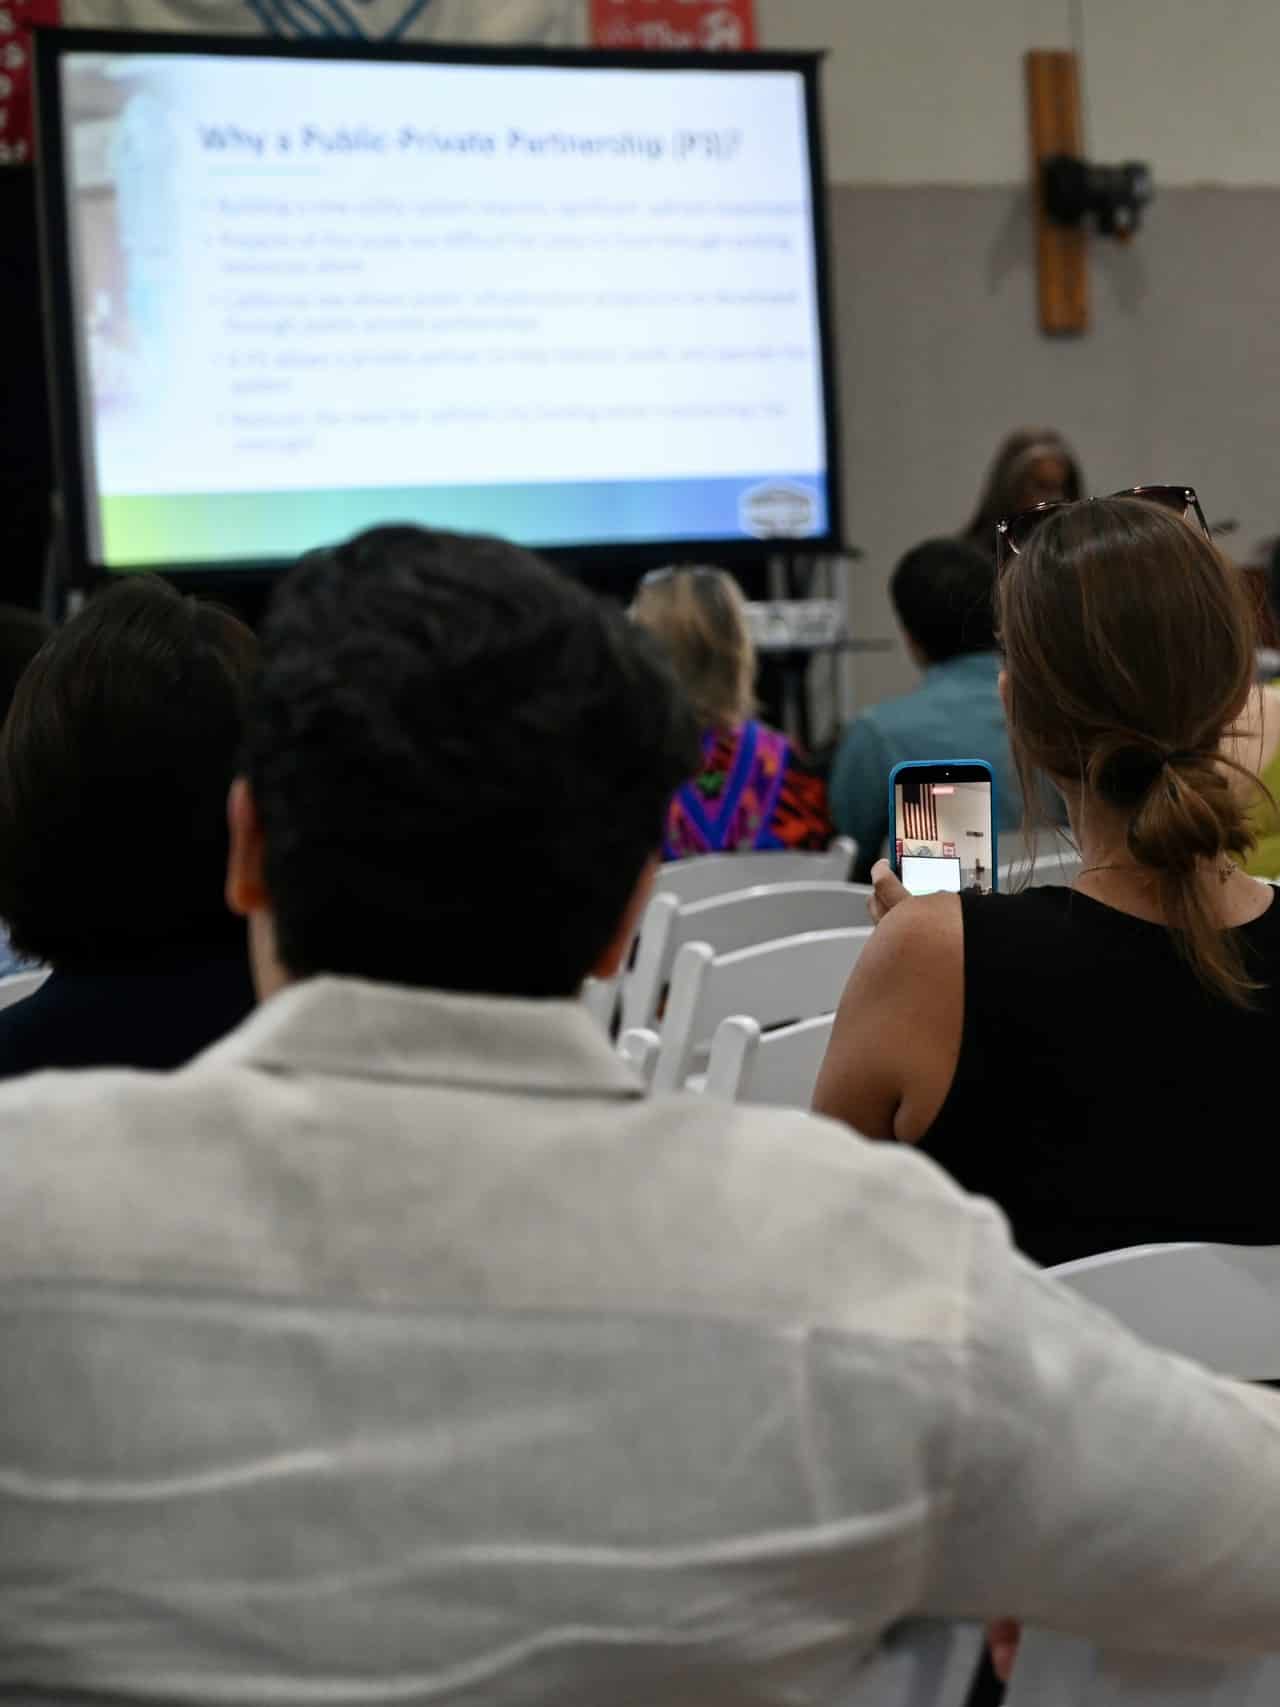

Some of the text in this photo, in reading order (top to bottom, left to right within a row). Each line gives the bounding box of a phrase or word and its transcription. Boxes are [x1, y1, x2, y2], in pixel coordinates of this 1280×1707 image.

[198, 124, 262, 158] Why
[275, 132, 289, 150] a
[506, 126, 664, 162] Partnership
